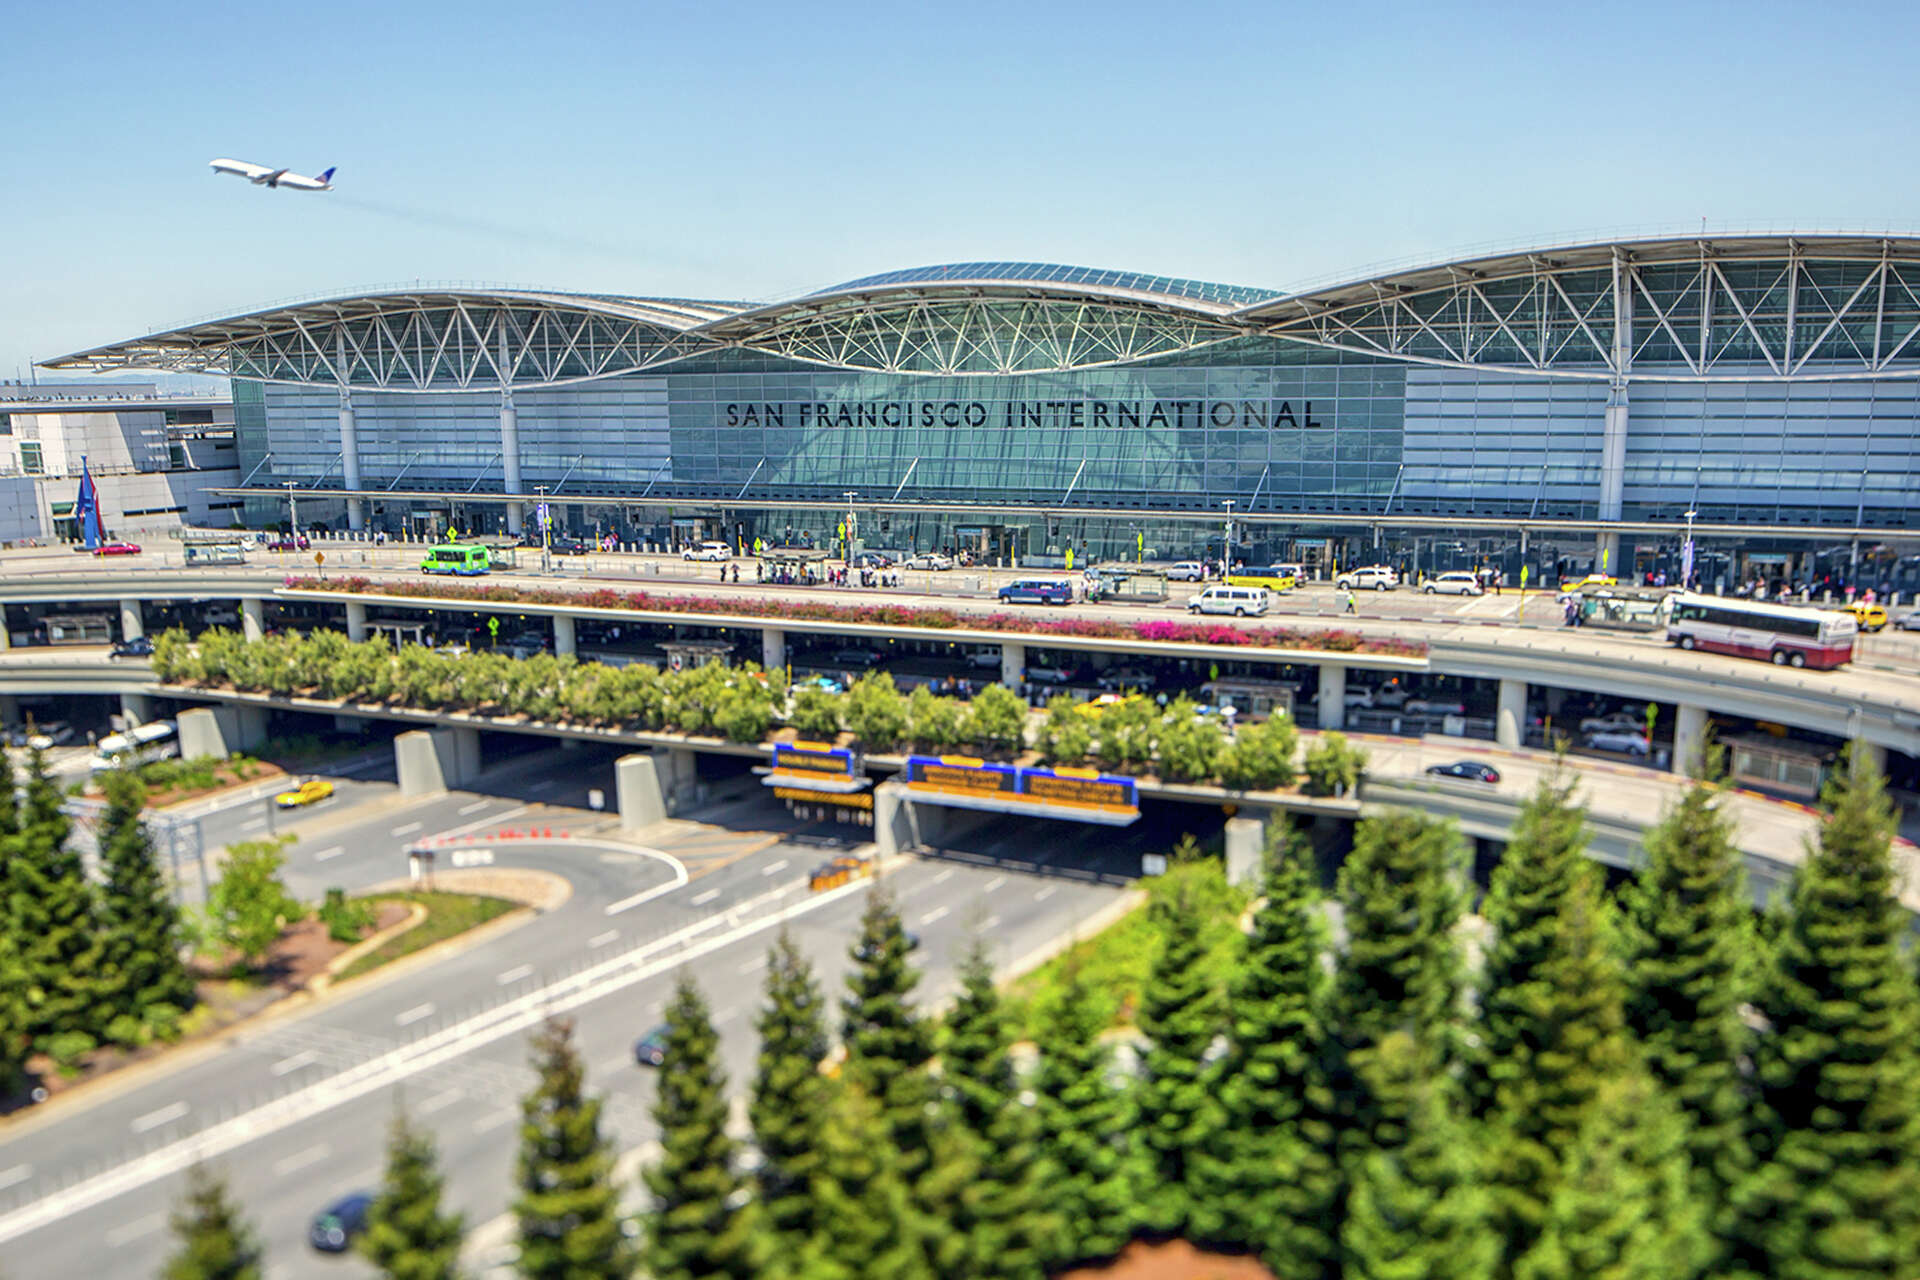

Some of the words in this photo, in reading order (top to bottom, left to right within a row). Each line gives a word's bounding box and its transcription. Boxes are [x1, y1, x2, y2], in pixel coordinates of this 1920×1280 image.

[727, 402, 784, 428] SAN
[800, 402, 987, 428] FRANCISCO
[1007, 401, 1321, 428] INTERNATIONAL
